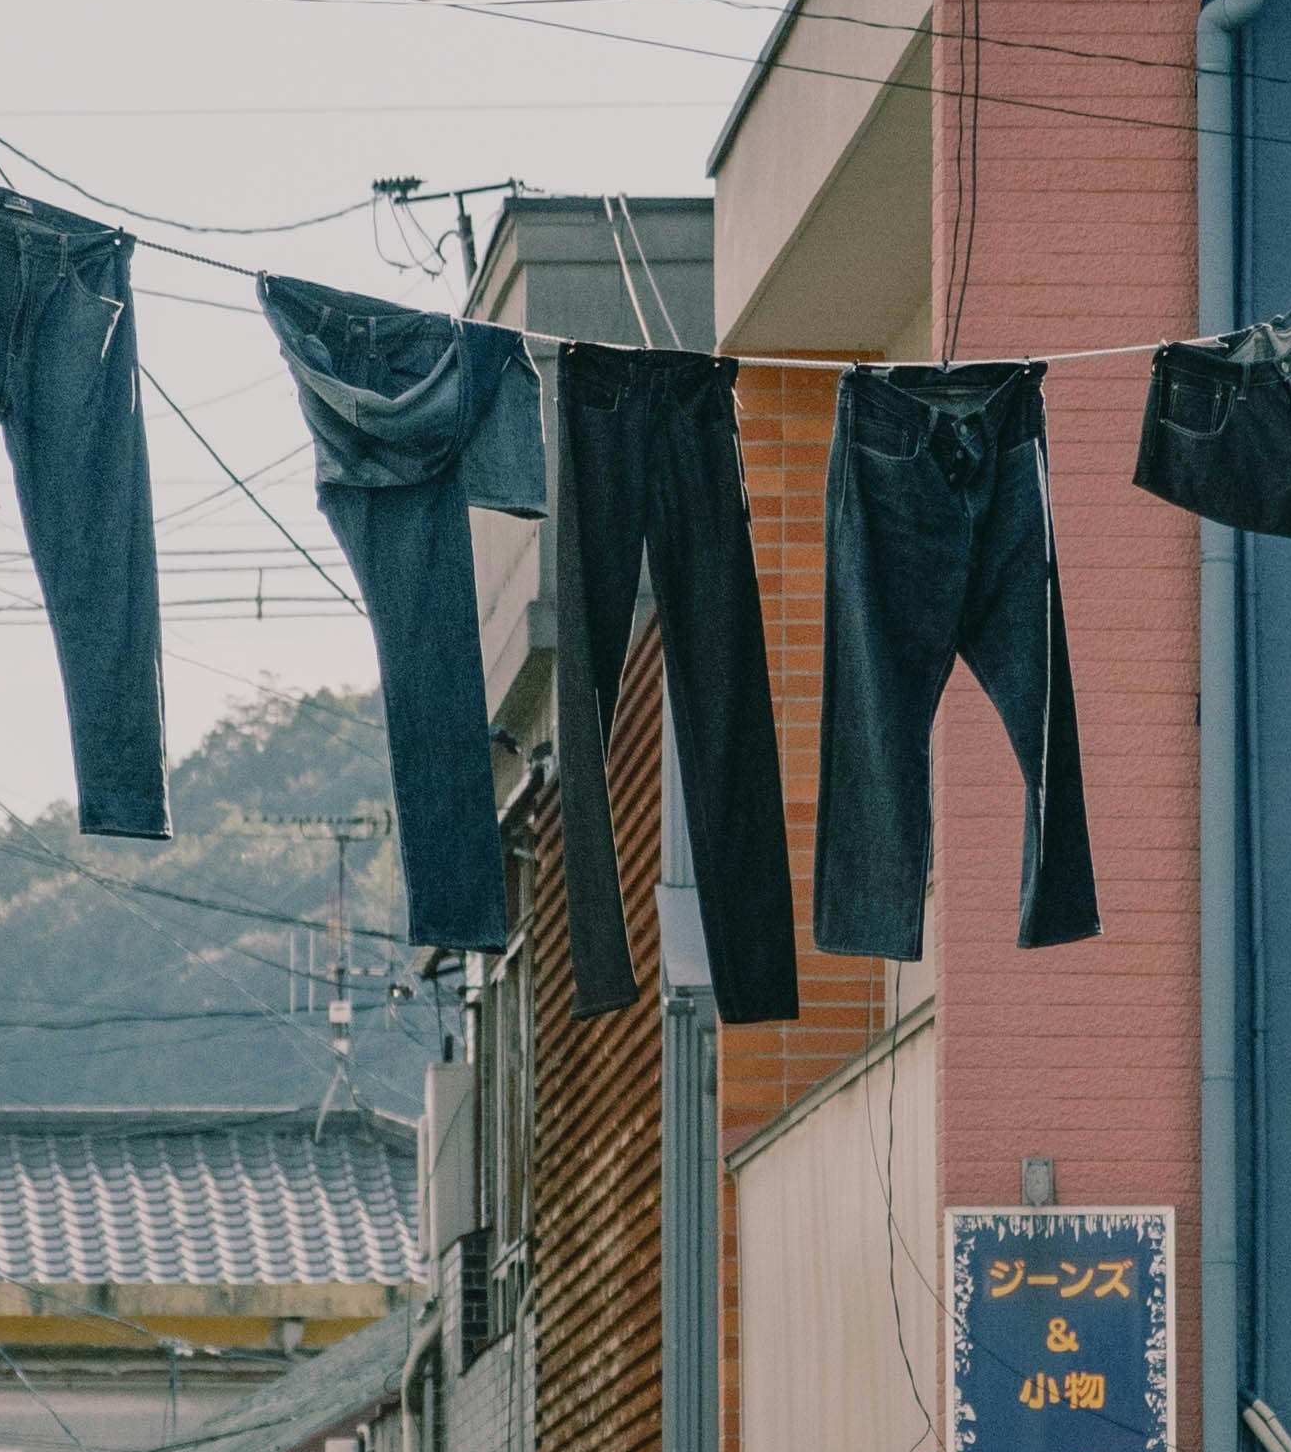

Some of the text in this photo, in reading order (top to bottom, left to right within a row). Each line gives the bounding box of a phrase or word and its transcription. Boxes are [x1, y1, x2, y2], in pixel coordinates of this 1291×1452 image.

[988, 1260, 1132, 1299] ジーンズ
[1046, 1317, 1080, 1353] &
[1019, 1373, 1107, 1410] 小物
